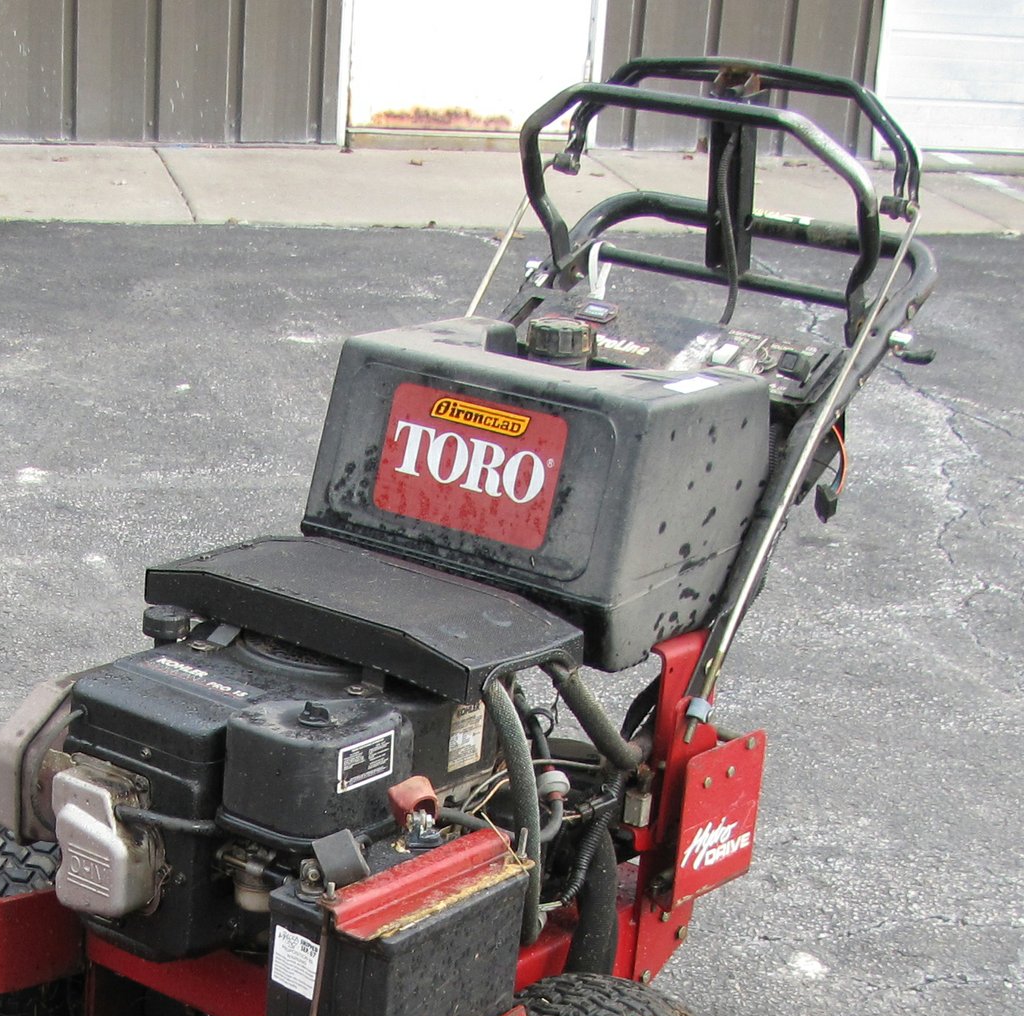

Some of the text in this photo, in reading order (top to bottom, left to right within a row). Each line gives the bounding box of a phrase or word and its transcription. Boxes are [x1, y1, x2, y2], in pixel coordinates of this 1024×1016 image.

[394, 420, 546, 504] TORO
[156, 657, 209, 678] KOHLER
[704, 832, 751, 866] DRIVE
